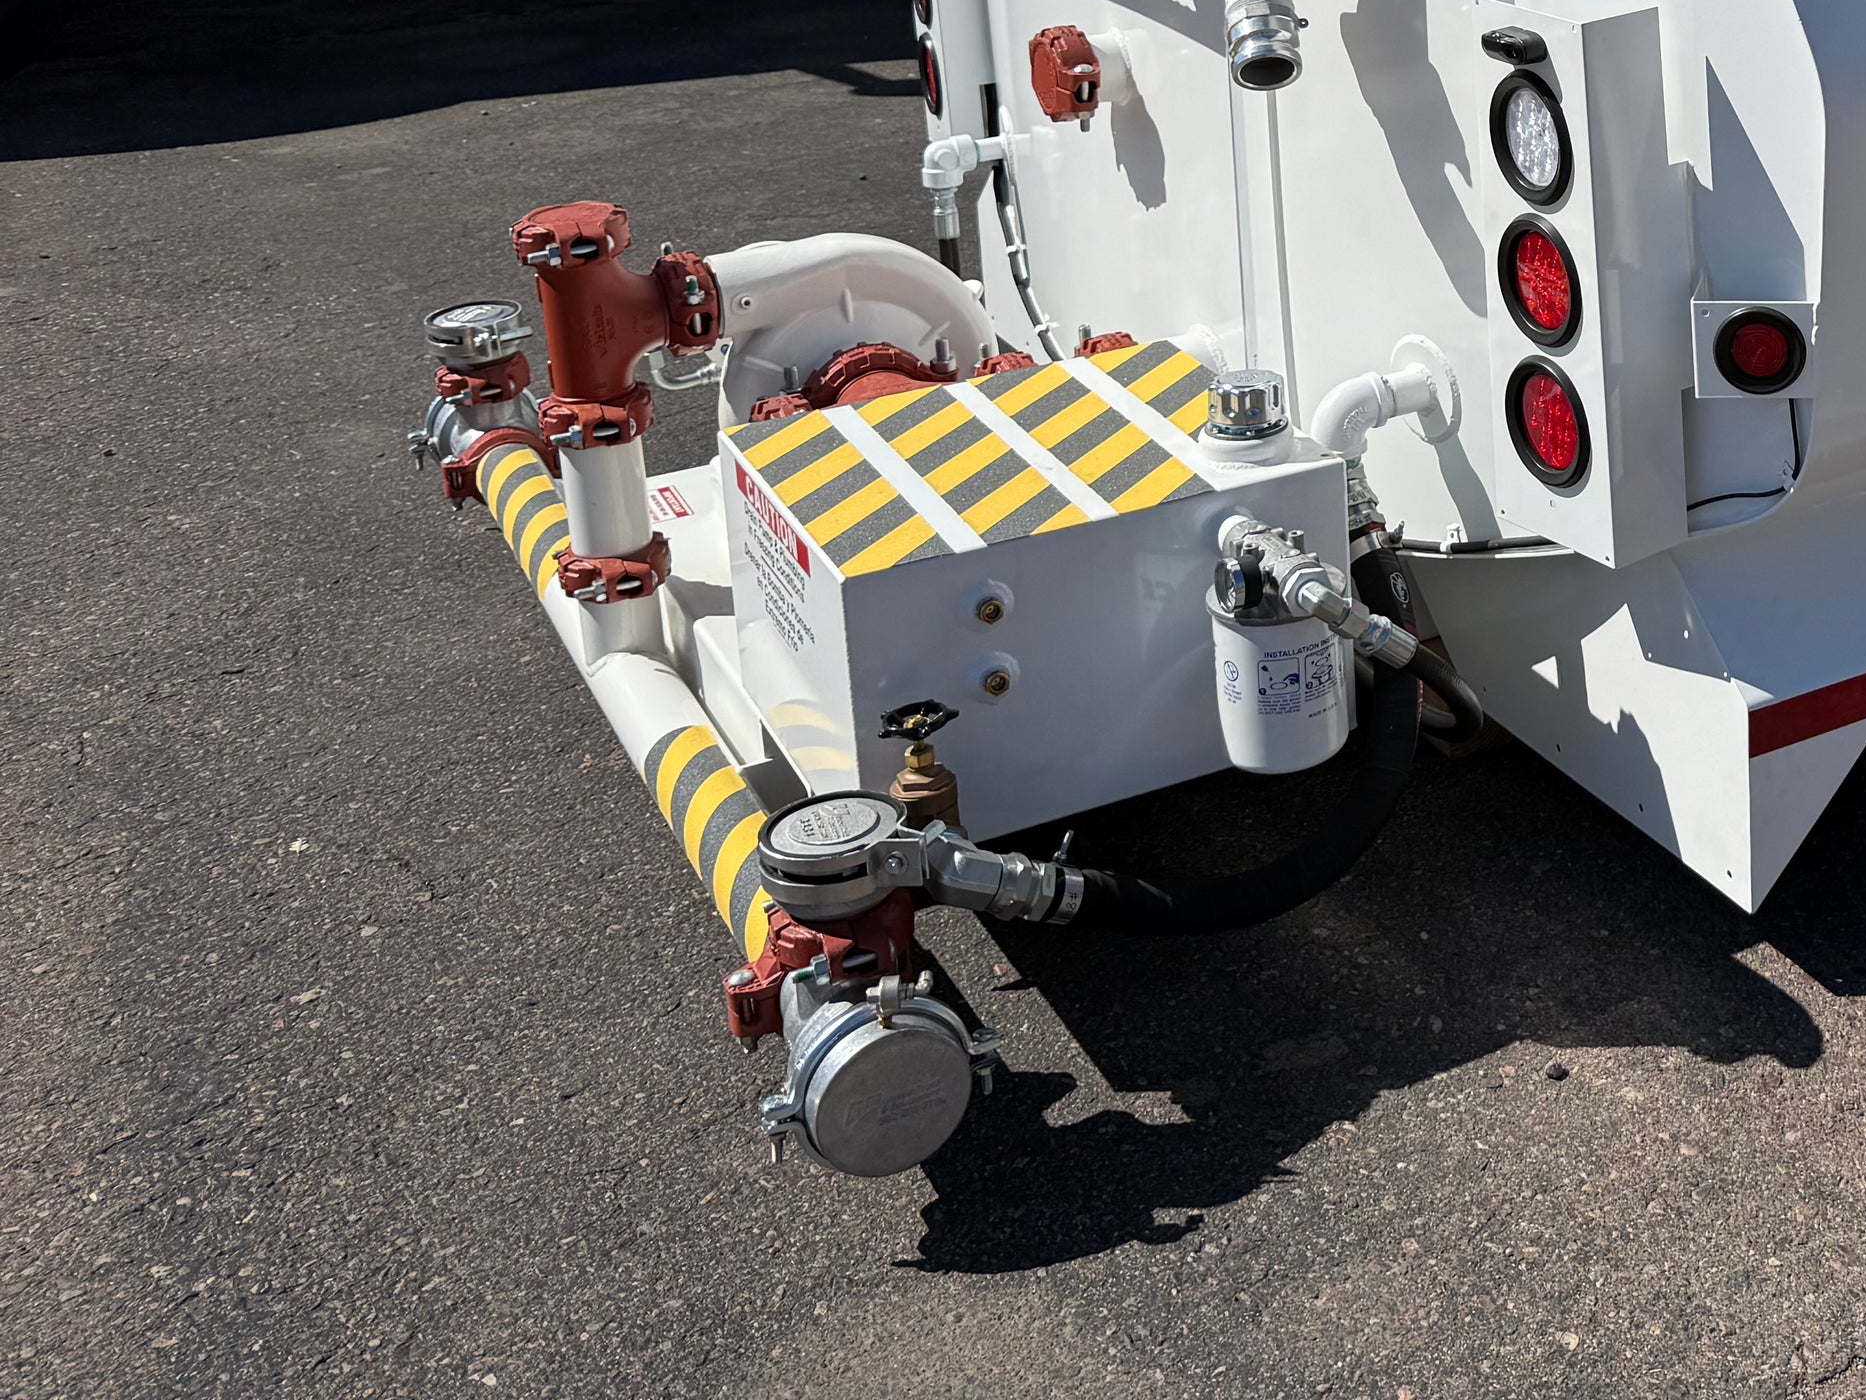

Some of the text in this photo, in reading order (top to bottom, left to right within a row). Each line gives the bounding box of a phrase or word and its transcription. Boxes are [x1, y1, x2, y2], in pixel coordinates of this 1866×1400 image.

[745, 475, 799, 561] CAUTION
[753, 528, 775, 568] Freezing
[776, 556, 805, 603] Conditions
[1264, 641, 1320, 658] INSTALLATION
